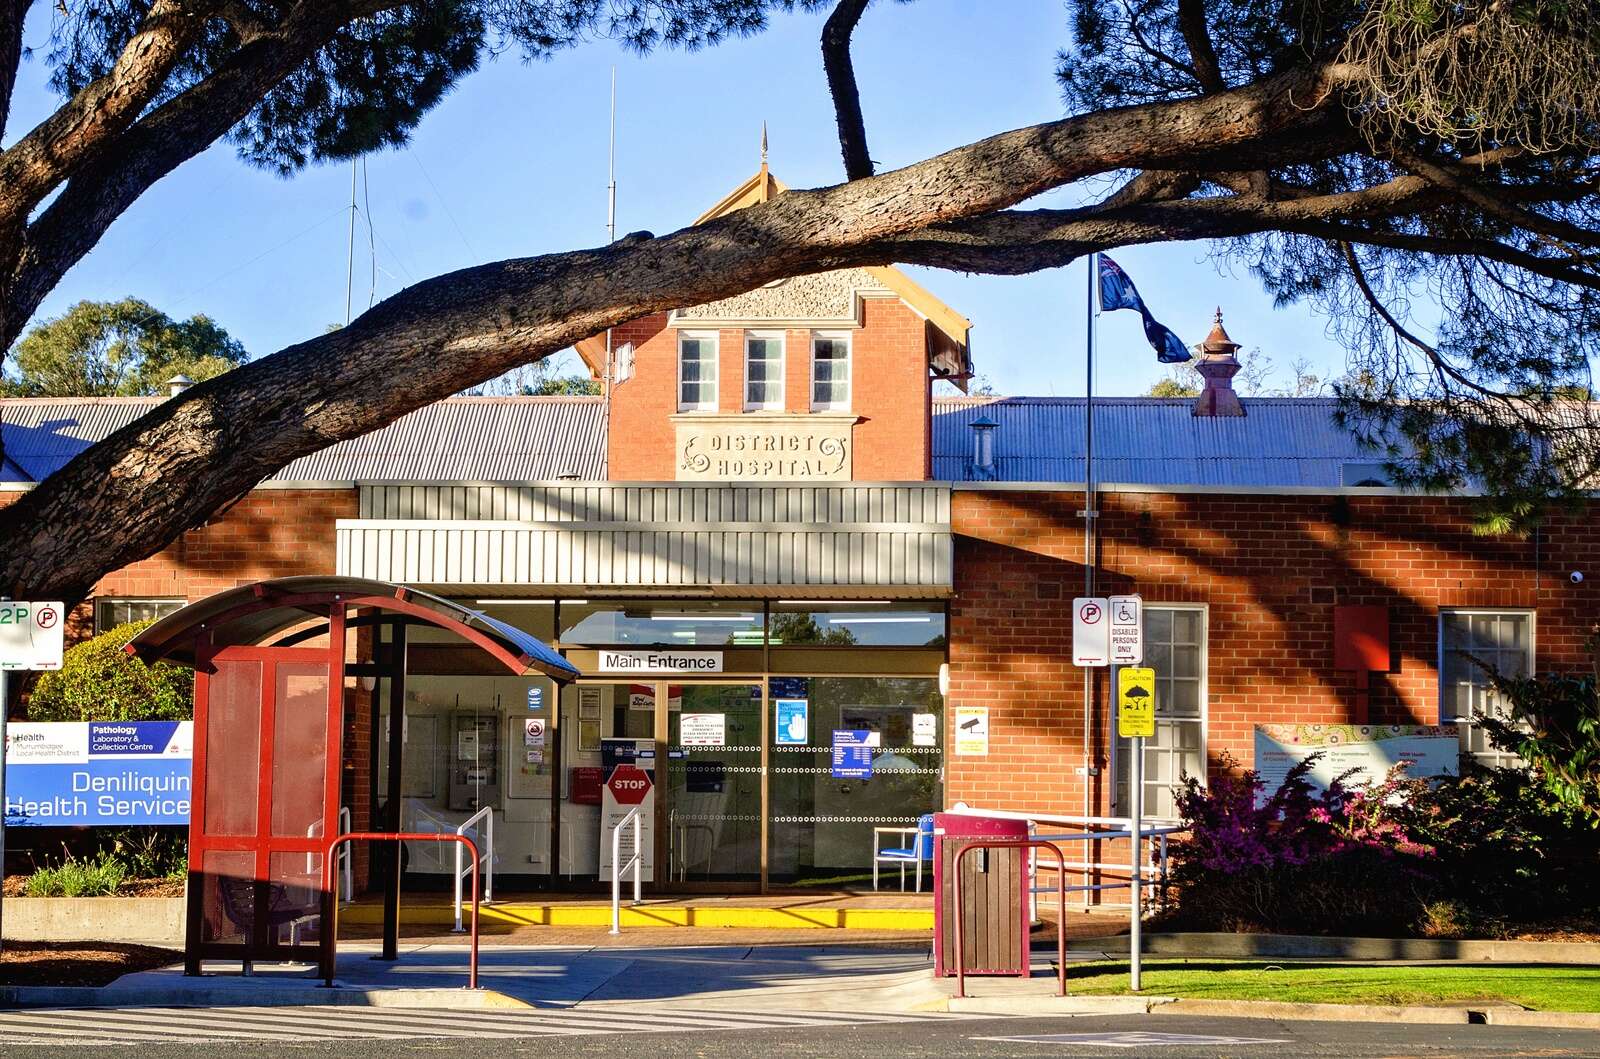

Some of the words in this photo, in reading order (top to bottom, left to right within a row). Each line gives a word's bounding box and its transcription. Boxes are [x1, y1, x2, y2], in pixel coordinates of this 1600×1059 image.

[711, 434, 814, 452] DISTRICT
[717, 459, 829, 476] HOSPITAL
[0, 608, 28, 624] 2P
[1111, 628, 1139, 636] DISABLED
[1111, 636, 1139, 644] PERSONS
[1117, 645, 1132, 653] ONLY
[606, 654, 641, 668] Main
[648, 655, 716, 669] Entrance
[93, 726, 138, 735] Pathology
[17, 733, 45, 742] Health
[16, 743, 63, 751] Murrumbidgee
[92, 743, 128, 751] Collection
[129, 743, 154, 751] Centre
[73, 771, 190, 797] Deniliquin
[614, 780, 646, 790] STOP
[5, 796, 87, 817] Health
[97, 795, 190, 817] Service
